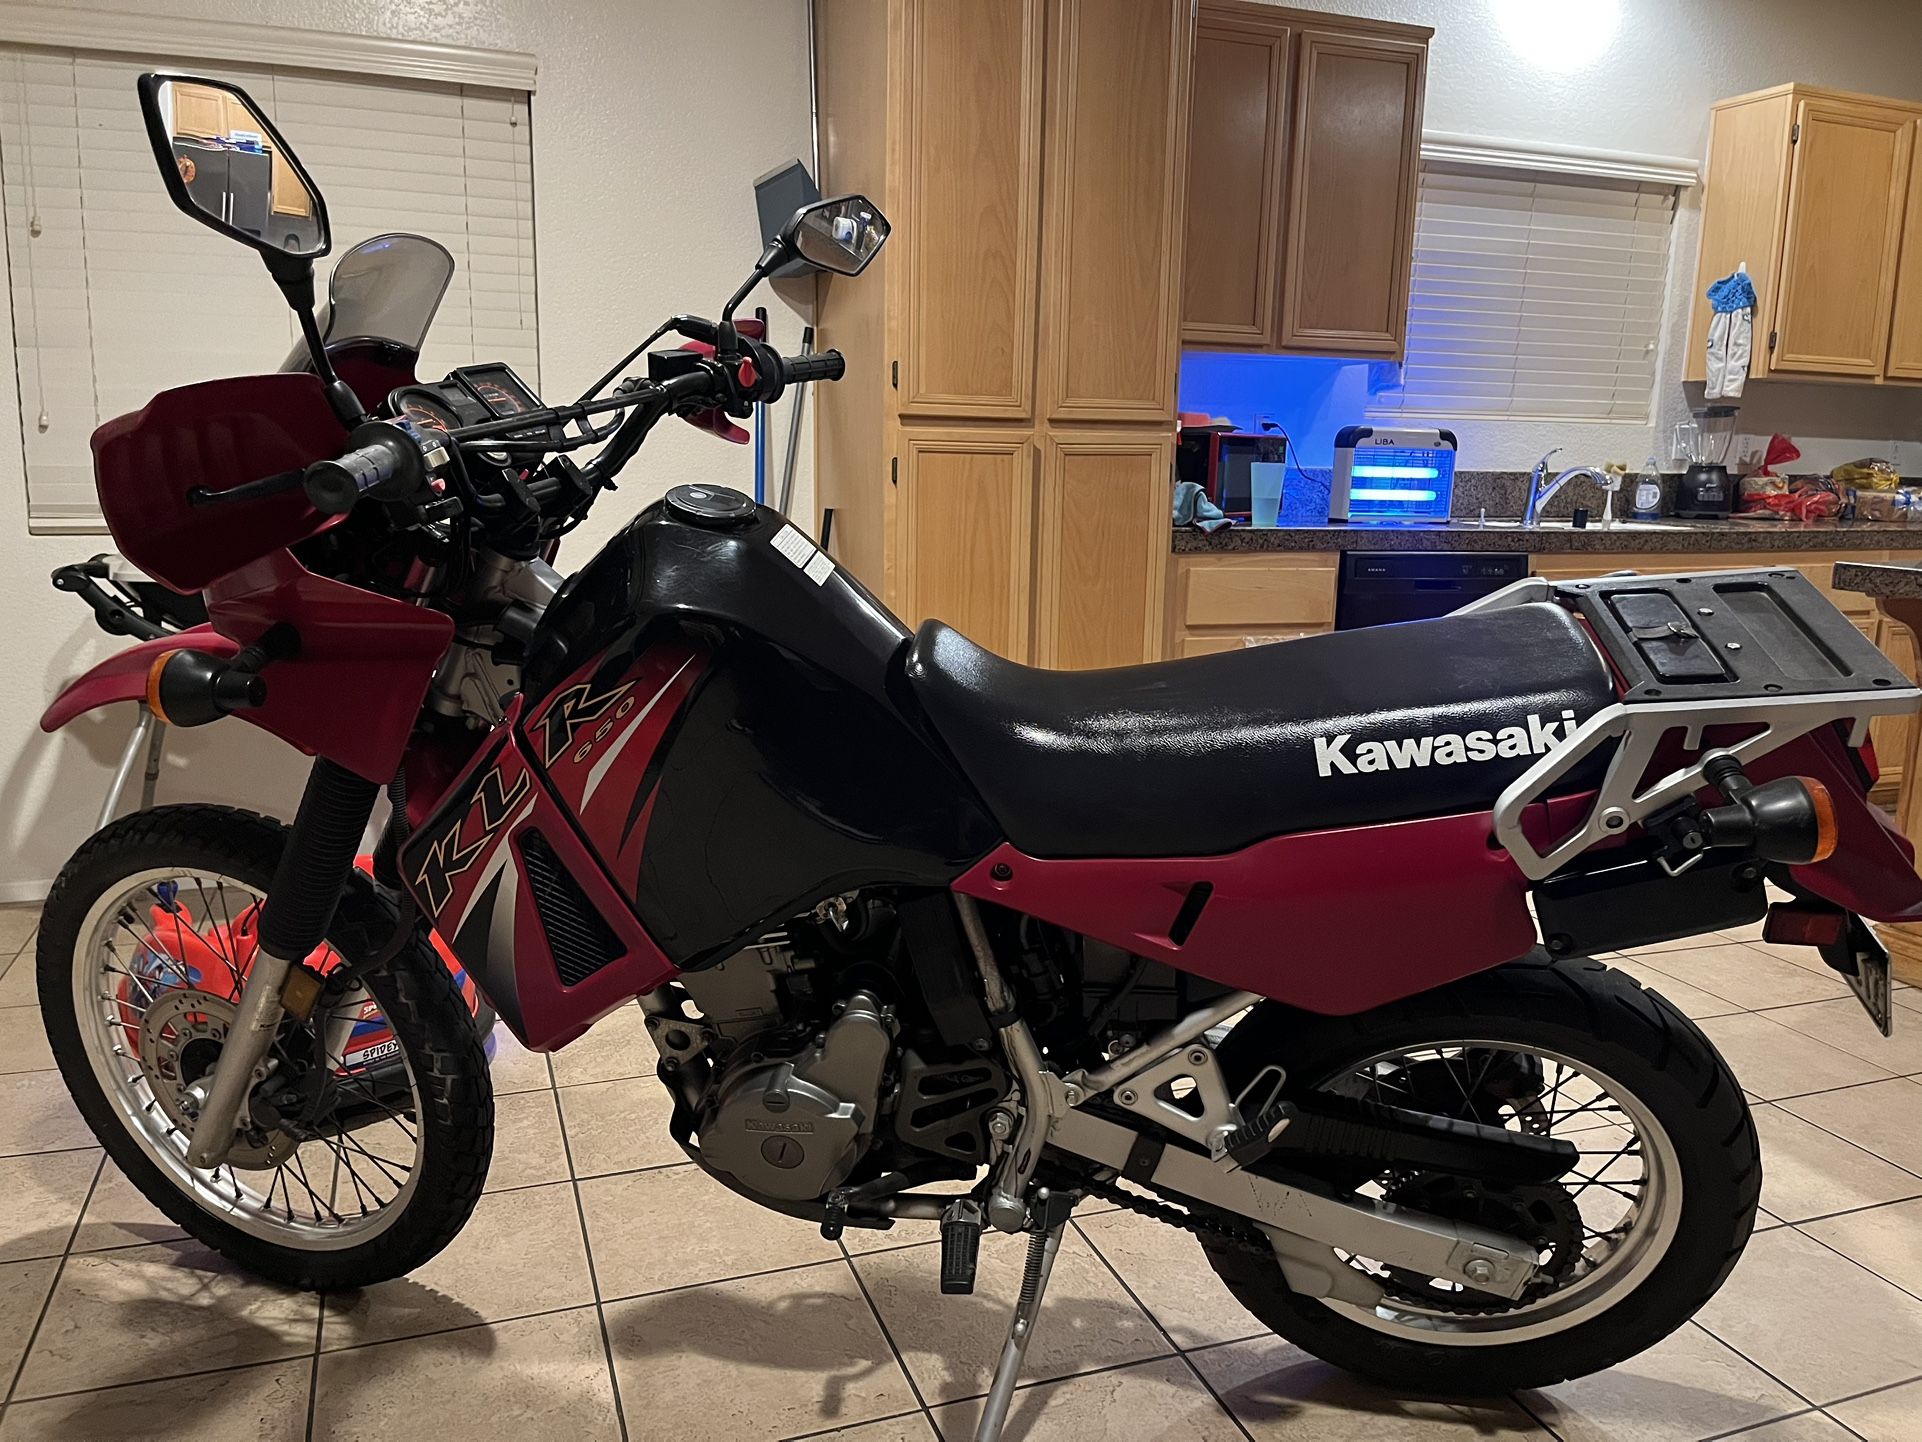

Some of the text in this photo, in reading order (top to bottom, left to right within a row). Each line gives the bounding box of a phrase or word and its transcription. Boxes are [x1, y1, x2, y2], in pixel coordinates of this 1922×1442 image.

[573, 696, 635, 763] 650
[1313, 710, 1578, 777] Kawasaki
[415, 680, 639, 918] KLR
